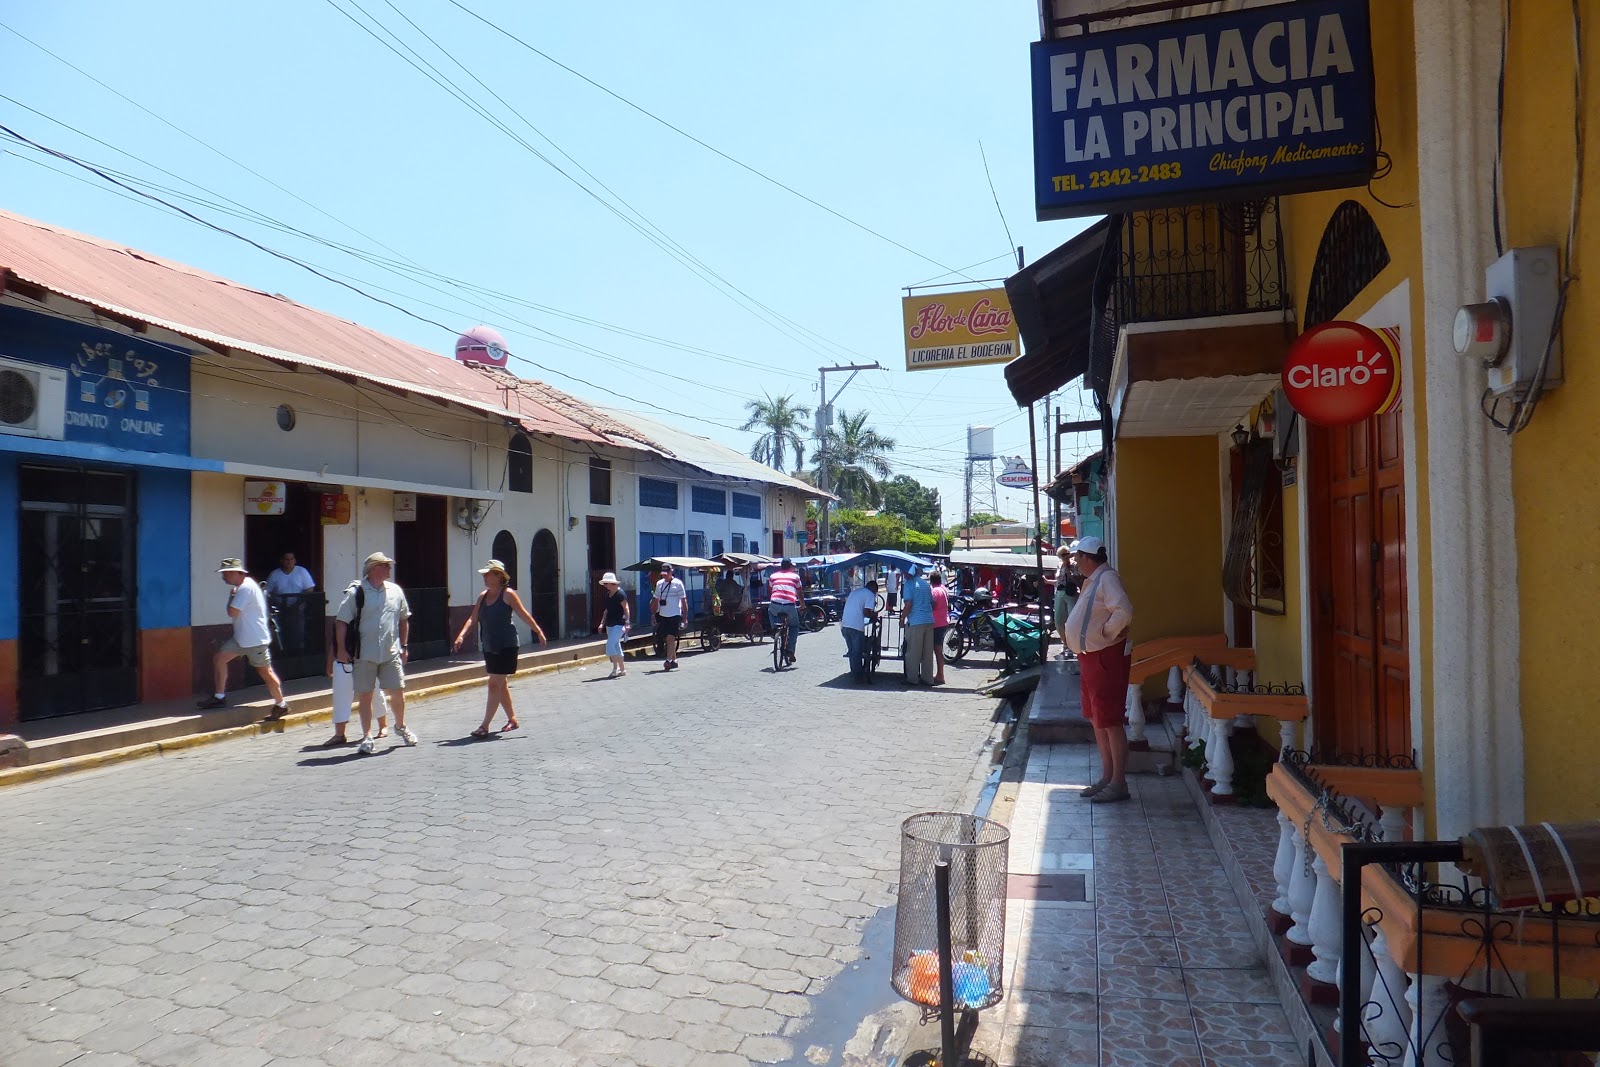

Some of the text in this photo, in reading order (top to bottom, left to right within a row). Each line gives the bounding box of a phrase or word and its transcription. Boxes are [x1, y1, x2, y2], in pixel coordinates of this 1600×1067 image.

[1050, 13, 1355, 112] FARMACIA
[1063, 85, 1344, 163] LA PRINCIPAL
[1271, 142, 1365, 165] Medicamentos
[1052, 162, 1182, 192] TEL. 2342-2483
[909, 297, 1012, 340] Flor de Caña
[912, 342, 1013, 363] LICORERIA EL BODEGON
[1287, 364, 1371, 389] Claro
[121, 418, 164, 436] ONLINE
